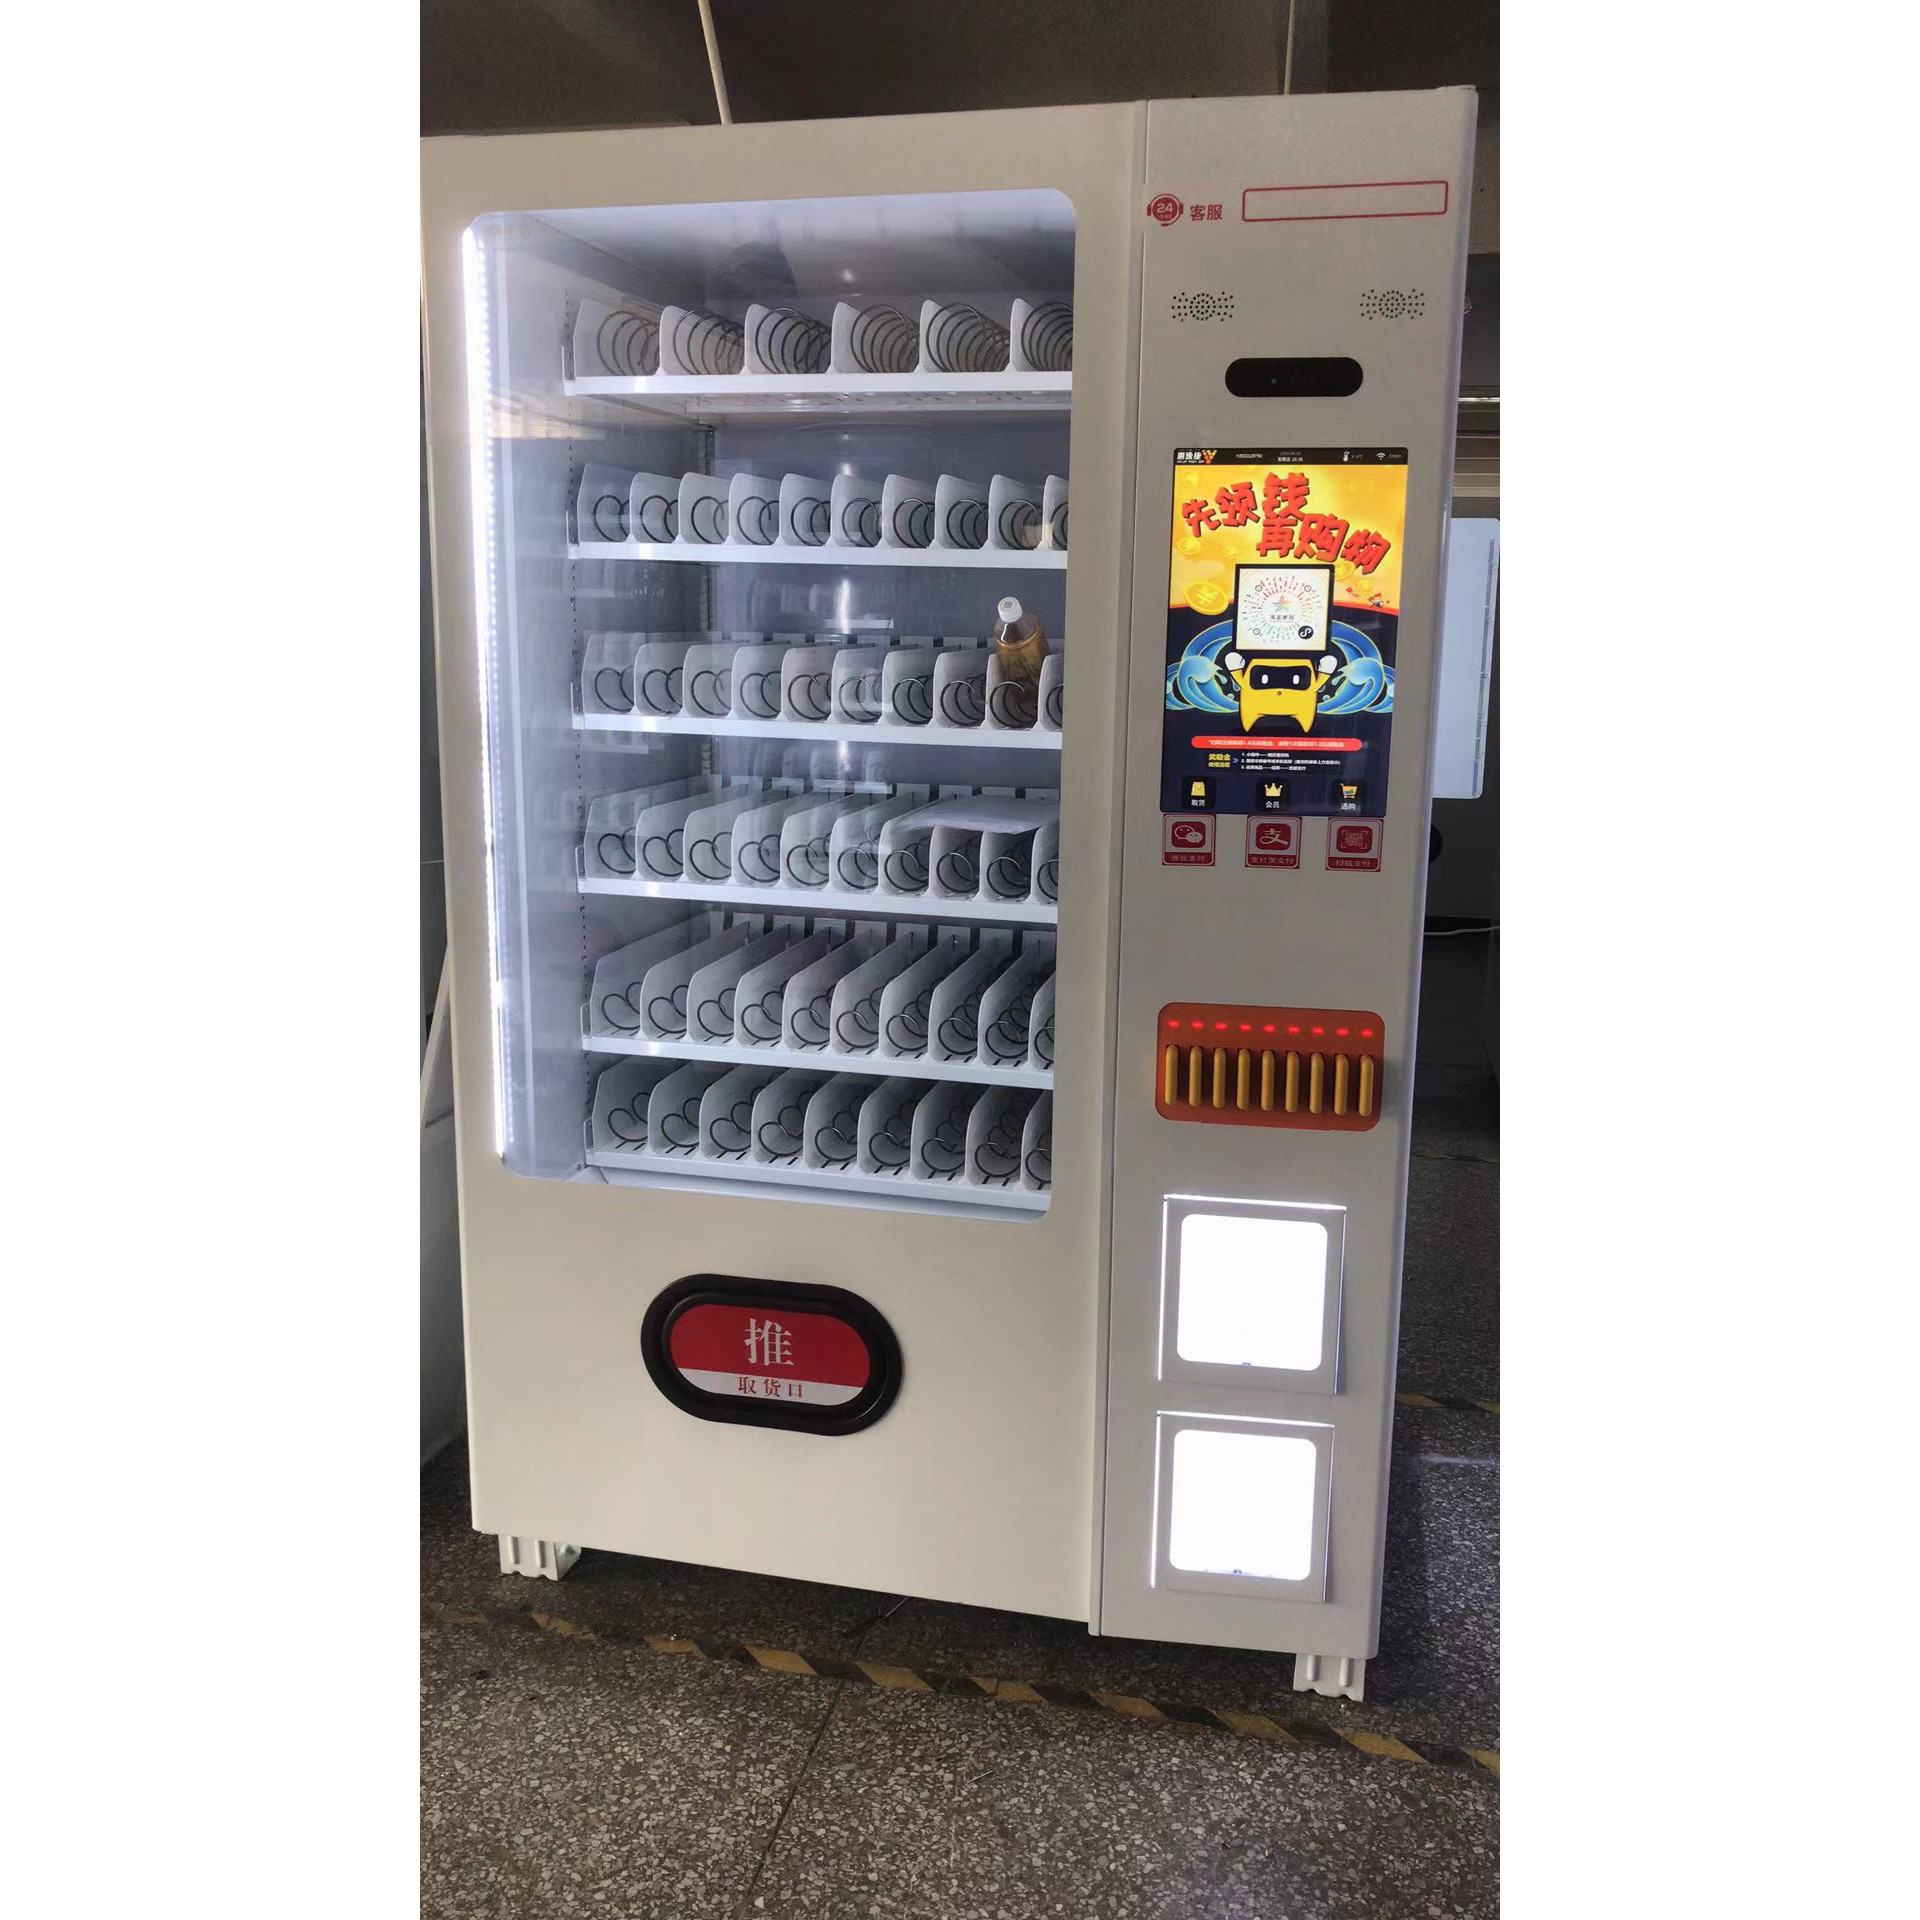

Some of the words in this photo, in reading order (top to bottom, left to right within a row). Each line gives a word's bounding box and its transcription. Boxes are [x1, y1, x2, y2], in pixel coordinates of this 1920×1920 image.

[1157, 203, 1173, 213] 24
[1190, 204, 1223, 221] 客服
[1181, 471, 1310, 537] 先领钱
[1256, 512, 1392, 575] 再购物
[1191, 799, 1206, 807] 取货
[1265, 800, 1280, 809] 会员
[1170, 854, 1205, 862] 微信支付
[1250, 856, 1294, 865] 支付宝支付
[743, 1317, 795, 1367] 推
[737, 1375, 803, 1398] 取货口
